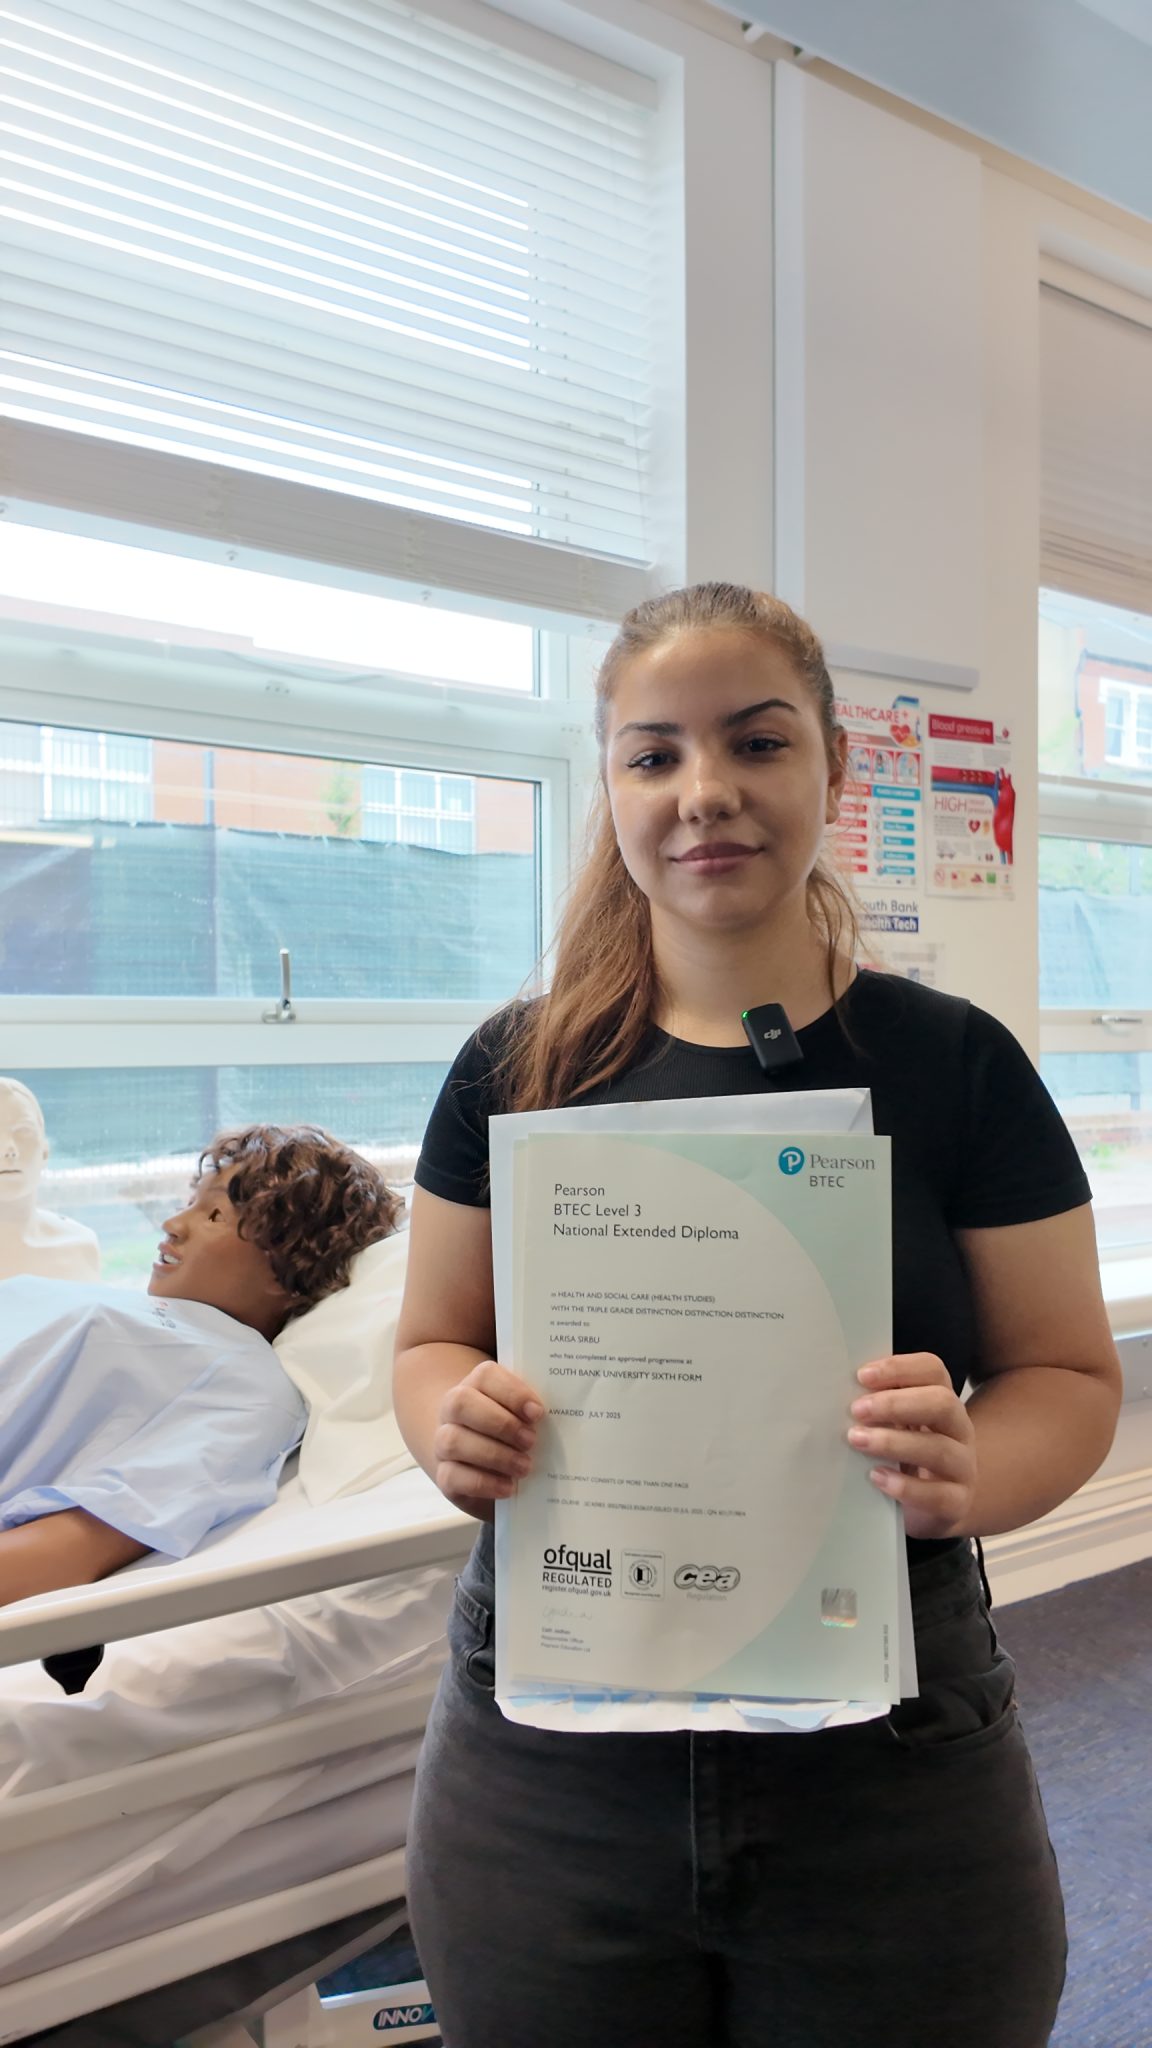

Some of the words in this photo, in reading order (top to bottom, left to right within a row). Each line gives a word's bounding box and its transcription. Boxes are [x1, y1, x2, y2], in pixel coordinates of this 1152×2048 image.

[834, 703, 900, 724] EALTHCARE
[931, 718, 955, 732] Blood
[956, 722, 991, 737] pressure
[934, 796, 967, 813] HIGH
[890, 900, 919, 913] Bank
[893, 917, 917, 931] Tech
[809, 1154, 876, 1170] Pearson
[809, 1176, 845, 1188] BTEC
[554, 1184, 605, 1196] Pearson
[554, 1203, 591, 1216] BTEC
[595, 1204, 629, 1217] Level
[634, 1204, 642, 1217] 3
[553, 1224, 608, 1237] National
[613, 1224, 676, 1239] Extended
[681, 1225, 739, 1243] Diploma
[558, 1291, 585, 1299] HEALTH
[586, 1292, 602, 1300] AND
[604, 1292, 629, 1301] SOCIAL
[630, 1293, 649, 1301] CARE
[651, 1293, 682, 1302] (HEALTH
[684, 1295, 716, 1304] STUDIES)
[571, 1305, 585, 1313] THE
[586, 1306, 608, 1314] TRIPLE
[609, 1306, 634, 1315] GRADE
[635, 1307, 683, 1317] DISTINCTION
[684, 1309, 733, 1318] DISTINCTION
[734, 1311, 785, 1320] DISTINCTION
[549, 1335, 576, 1343] LARISA
[578, 1335, 600, 1344] SIRBU
[548, 1367, 577, 1376] SOUTH
[578, 1368, 601, 1377] BANK
[603, 1369, 650, 1379] UNIVERSITY
[651, 1371, 676, 1381] SIXTH
[678, 1373, 703, 1382] FORM
[548, 1408, 584, 1417] AWARDED
[588, 1410, 604, 1419] JULY
[543, 1544, 612, 1572] ofqual
[542, 1572, 612, 1589] REGULATED
[542, 1584, 611, 1597] register.ofqual.gov.uk
[377, 2005, 438, 2028] INNOV
